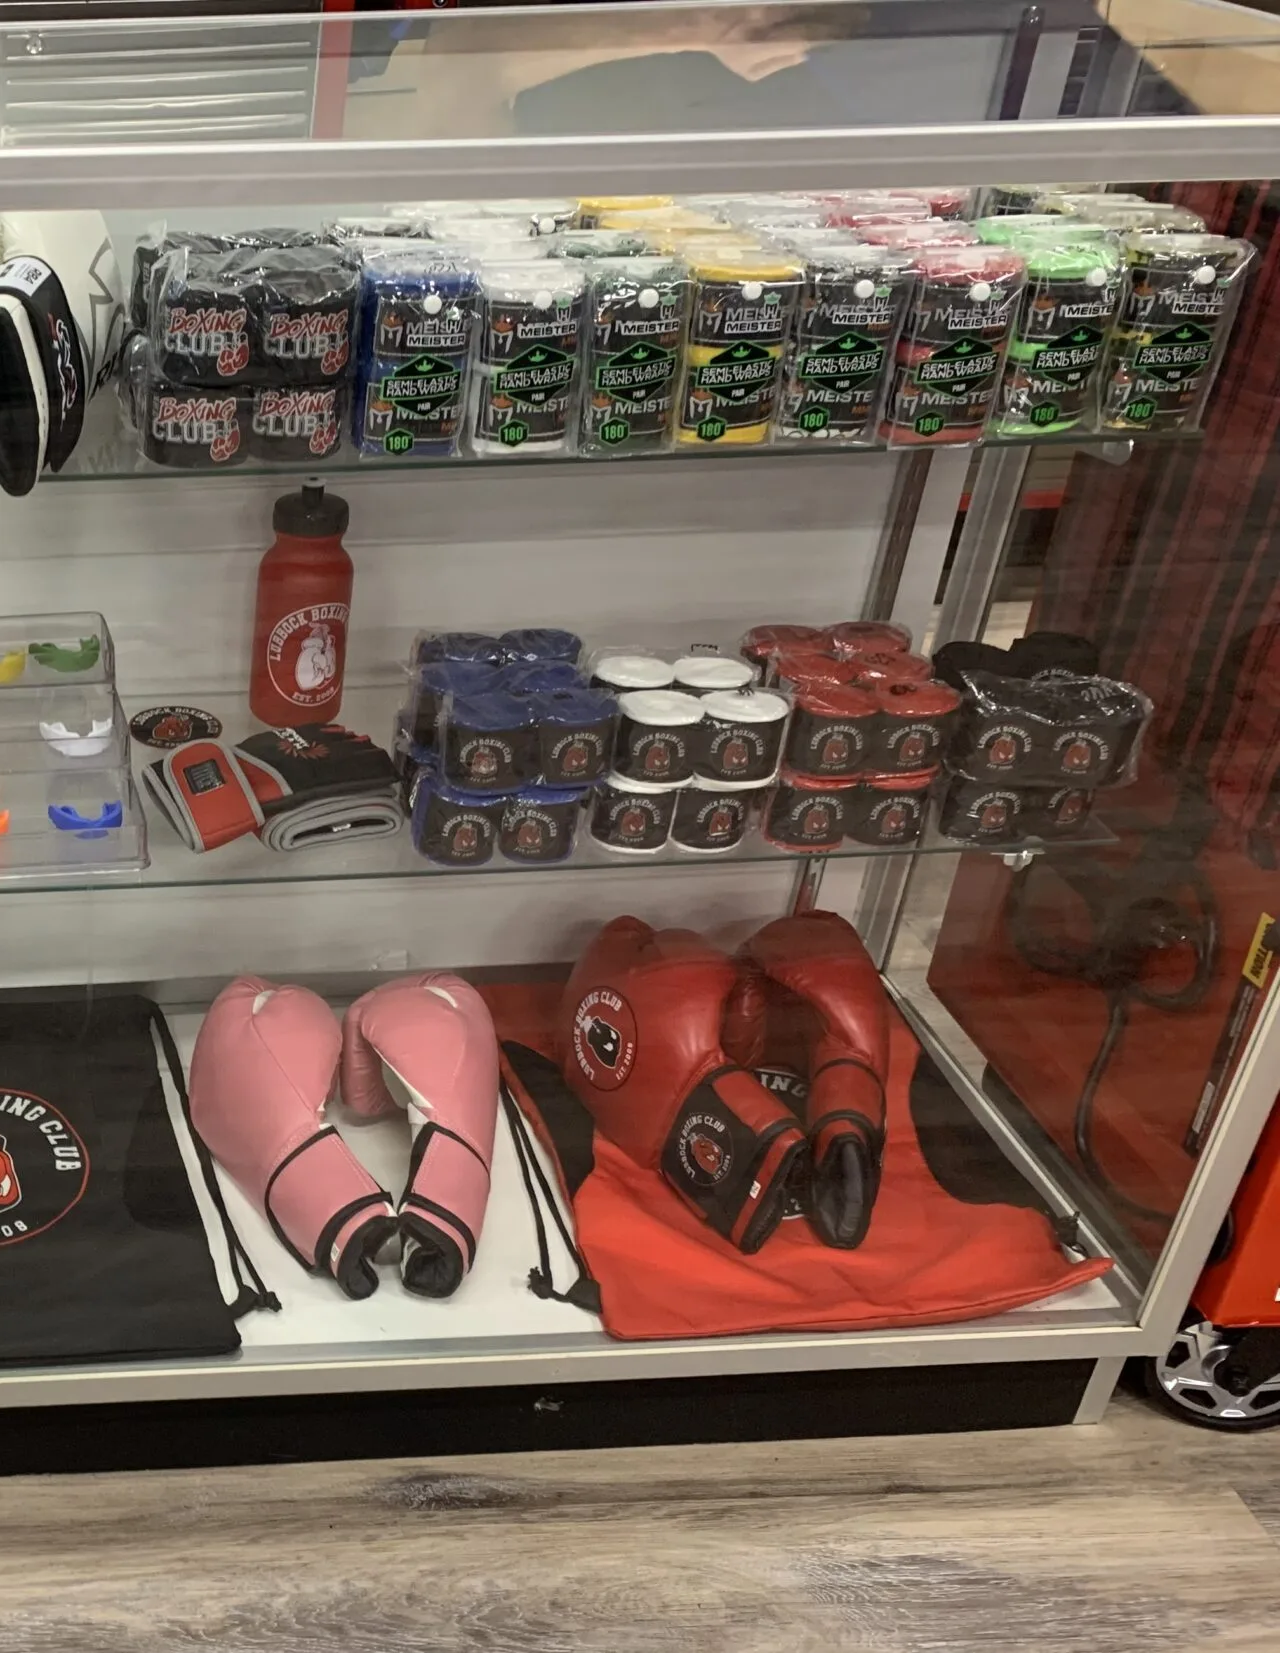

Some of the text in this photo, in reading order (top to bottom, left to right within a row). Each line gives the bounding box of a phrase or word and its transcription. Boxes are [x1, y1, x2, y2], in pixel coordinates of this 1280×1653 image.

[1069, 304, 1113, 316] MEISTE
[1173, 303, 1220, 313] MEISTE
[169, 307, 247, 334] BOXING
[270, 309, 349, 339] BOXING
[834, 313, 890, 323] MEISTER
[949, 315, 1006, 328] MEISTER
[520, 324, 576, 337] MEISTER
[623, 322, 679, 334] MEISTER
[726, 321, 782, 331] MEISTER
[164, 332, 227, 357] CLUB
[264, 333, 329, 359] CLUB
[408, 336, 465, 346] MEISTER
[808, 352, 880, 368] SEMI-ELASTIC
[1036, 353, 1097, 368] HAND WRA
[1038, 346, 1099, 360] SEMI-ELAS
[1139, 354, 1173, 364] HAND
[602, 360, 673, 377] SEMI-ELASTIC
[702, 360, 773, 376] SEMI-ELASTIC
[805, 360, 878, 374] HAND WRAPS
[921, 362, 994, 379] HAND WRAPS
[923, 354, 996, 372] SEMI-ELASTIC
[501, 363, 570, 381] SEMI-ELASTIC
[602, 368, 670, 386] HAND WRAPS
[701, 367, 771, 384] HAND WRAPS
[387, 374, 458, 389] SEMI-ELASTIC
[500, 372, 569, 389] HAND WRAPS
[836, 380, 850, 388] PAIR
[952, 384, 966, 392] PAIR
[1136, 379, 1199, 392] MEISTE
[387, 382, 457, 396] HAND WRAPS
[632, 390, 645, 399] PAIR
[731, 389, 745, 397] PAIR
[807, 390, 871, 403] MEISTE
[259, 389, 336, 417] BOXING
[532, 393, 545, 401] PAIR
[922, 391, 989, 405] MEISTE
[157, 397, 236, 425] BOXING
[418, 403, 431, 411] PAIR
[153, 417, 217, 444] CLUB
[252, 414, 318, 436] CLUB
[270, 612, 308, 662] LUBBOCK
[575, 992, 599, 1024] BOXING
[601, 992, 622, 1011] CLUB
[704, 1116, 725, 1132] CLUB
[38, 1119, 82, 1171] CLUB
